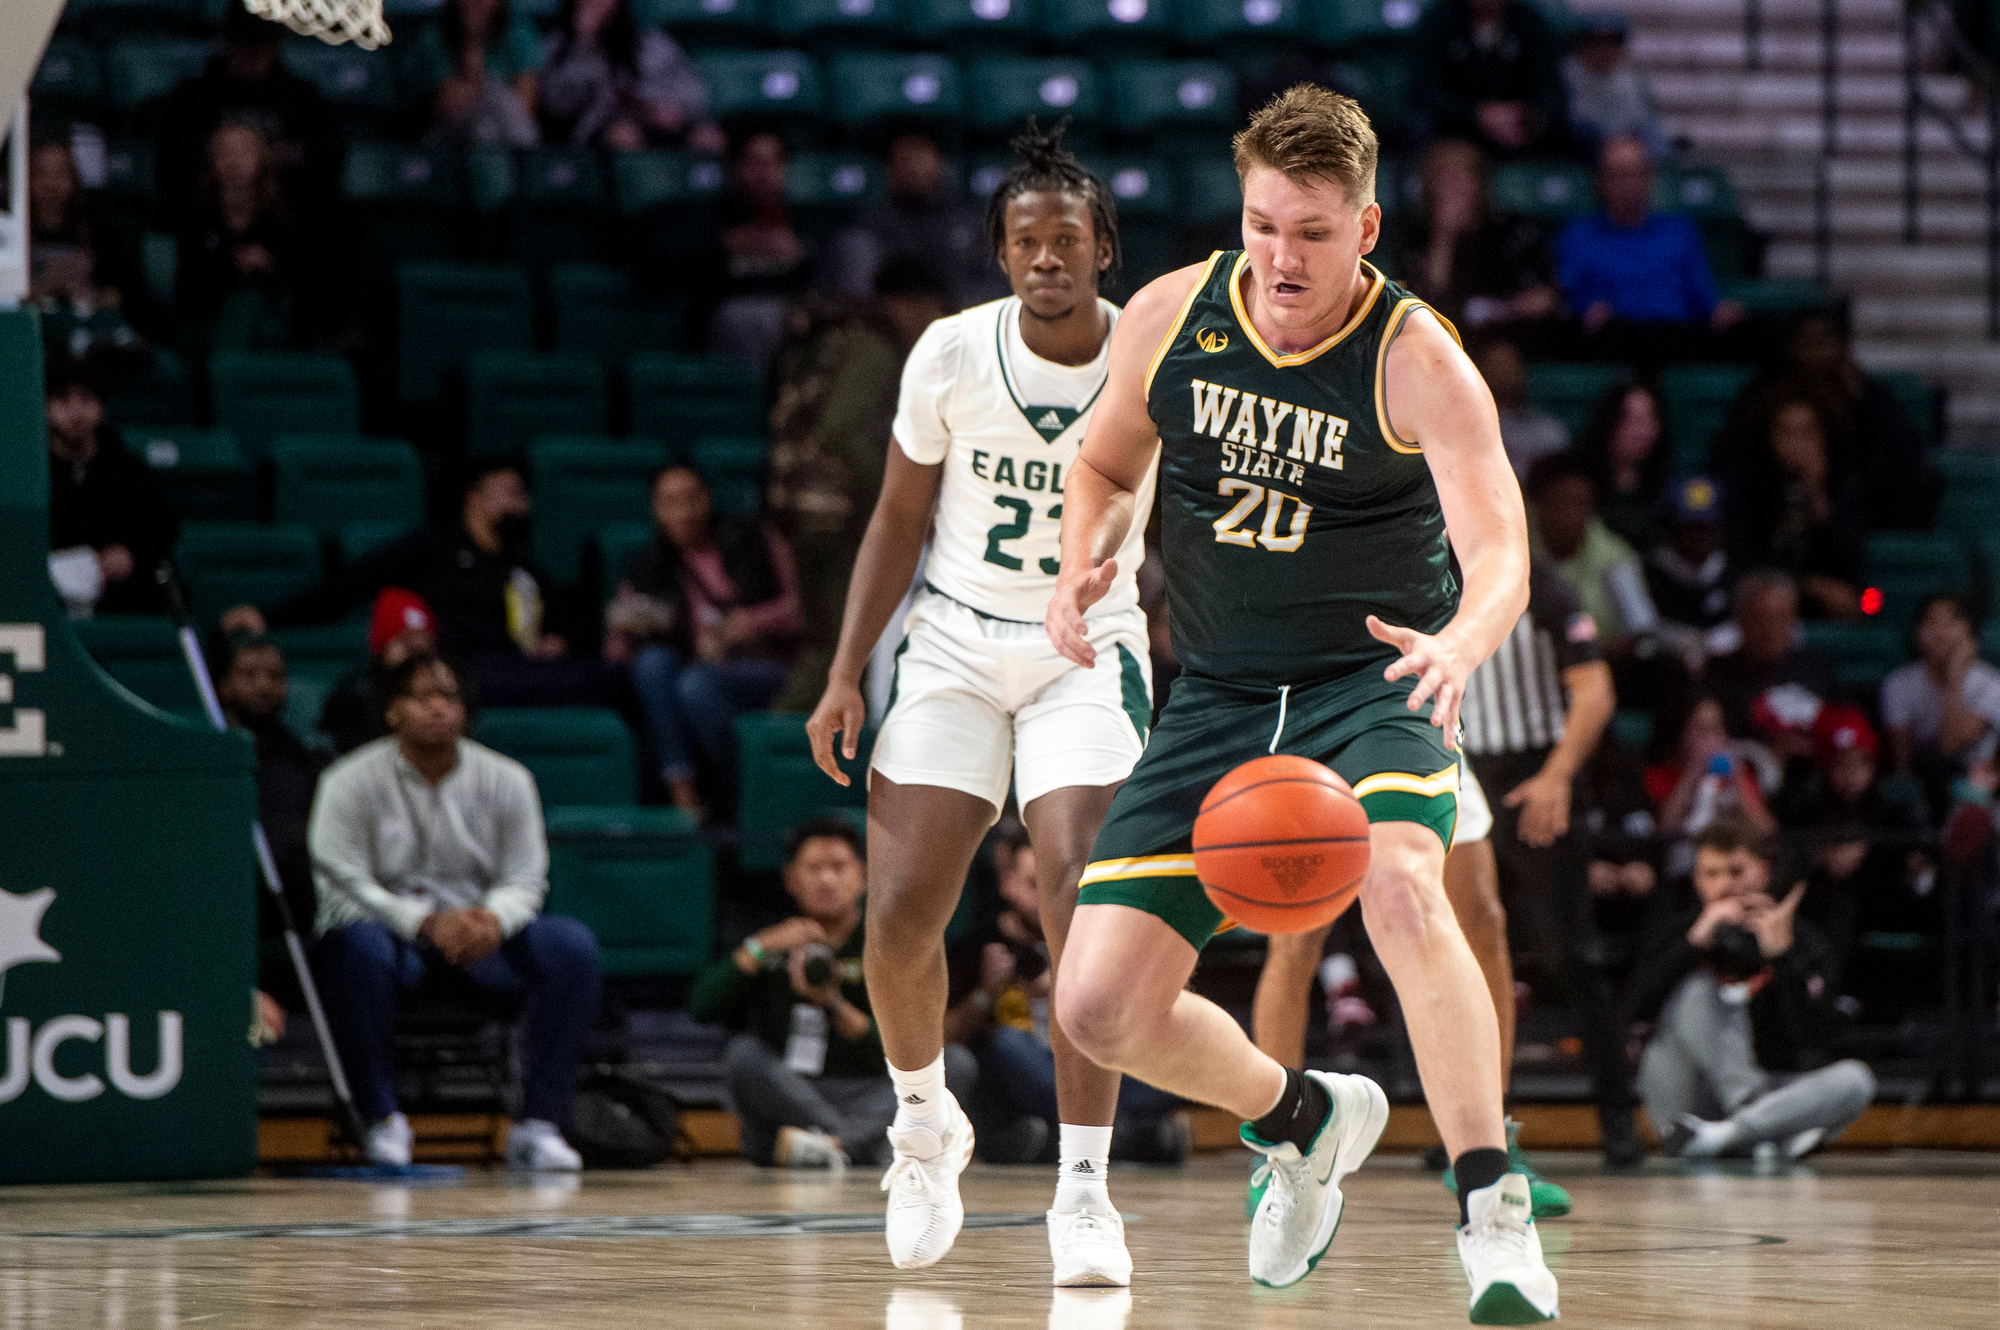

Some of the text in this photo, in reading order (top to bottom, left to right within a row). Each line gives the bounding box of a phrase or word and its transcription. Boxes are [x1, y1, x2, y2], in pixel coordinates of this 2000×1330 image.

[1190, 378, 1349, 471] WAYNE
[1220, 441, 1305, 487] STATE
[1212, 477, 1314, 553] 20
